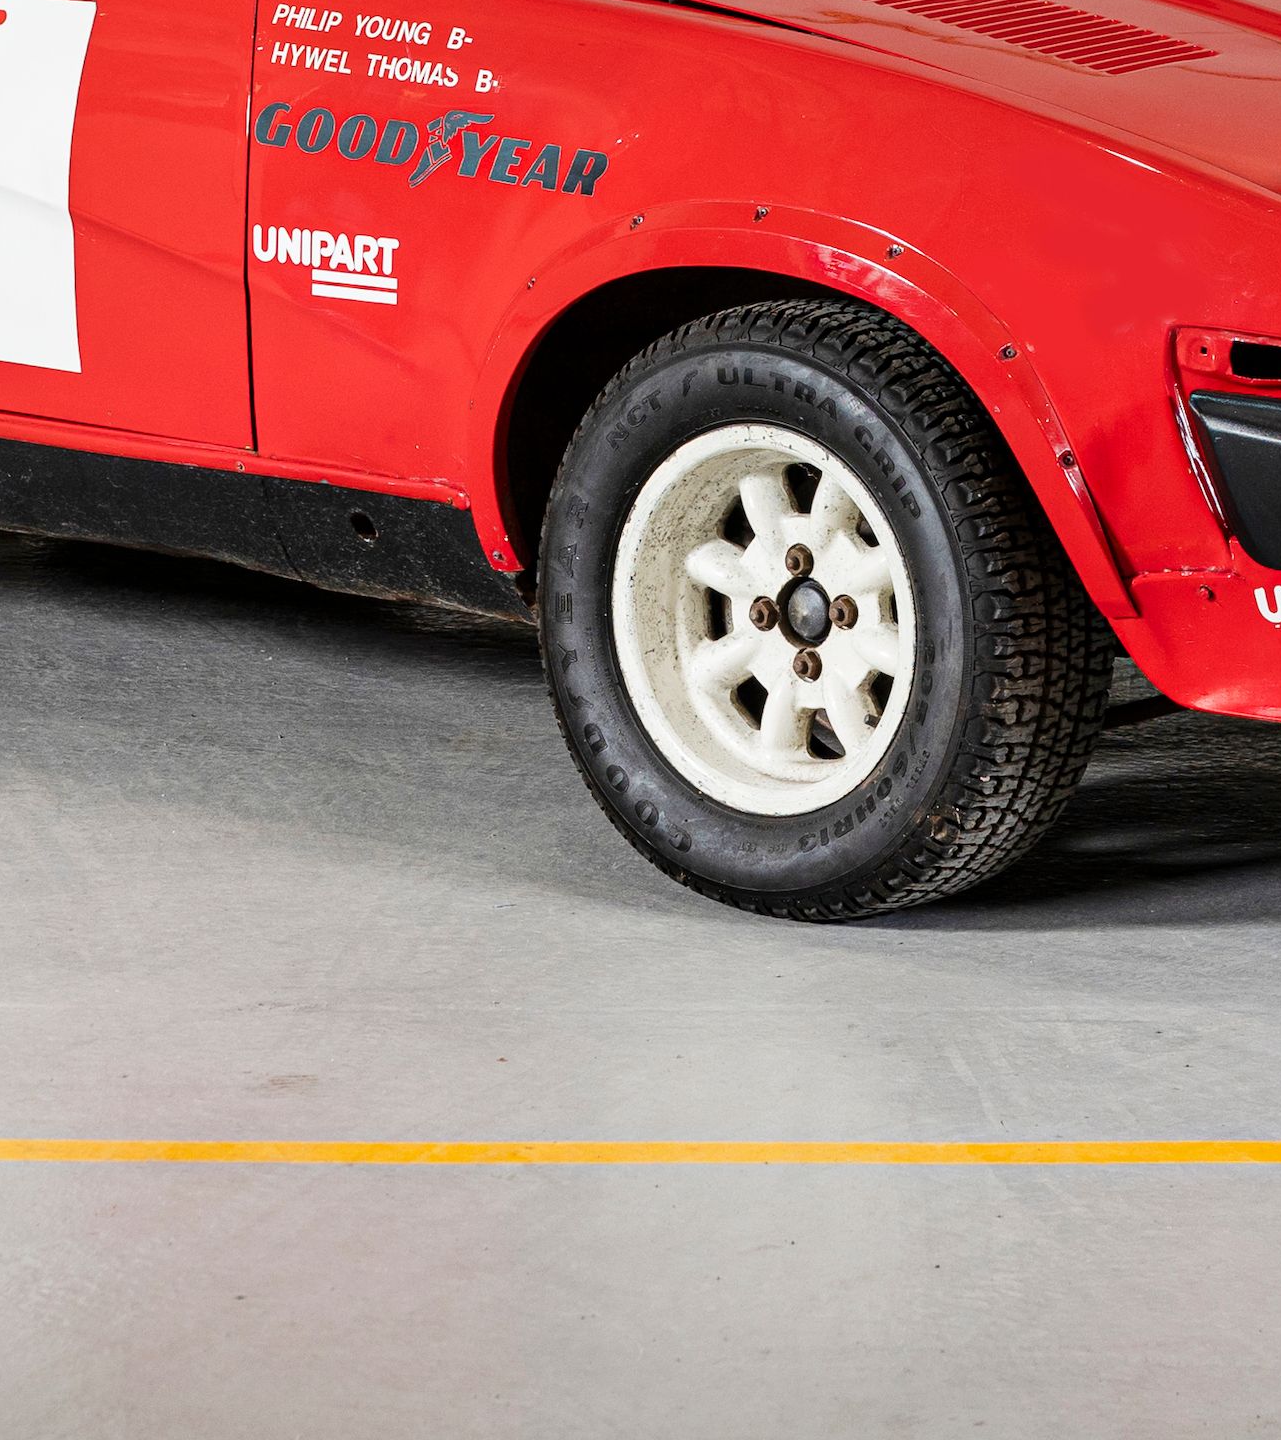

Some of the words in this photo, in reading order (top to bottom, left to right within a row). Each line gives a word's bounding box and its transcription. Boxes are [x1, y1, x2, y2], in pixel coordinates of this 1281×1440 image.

[272, 3, 342, 33] PHILIP
[354, 15, 432, 45] YOUNG
[271, 41, 352, 75] HYWEL
[367, 54, 459, 87] THOMAS
[253, 224, 400, 275] UNIPART
[605, 390, 662, 451] NCT
[718, 366, 839, 423] ULTRA
[854, 424, 922, 520] GRIP
